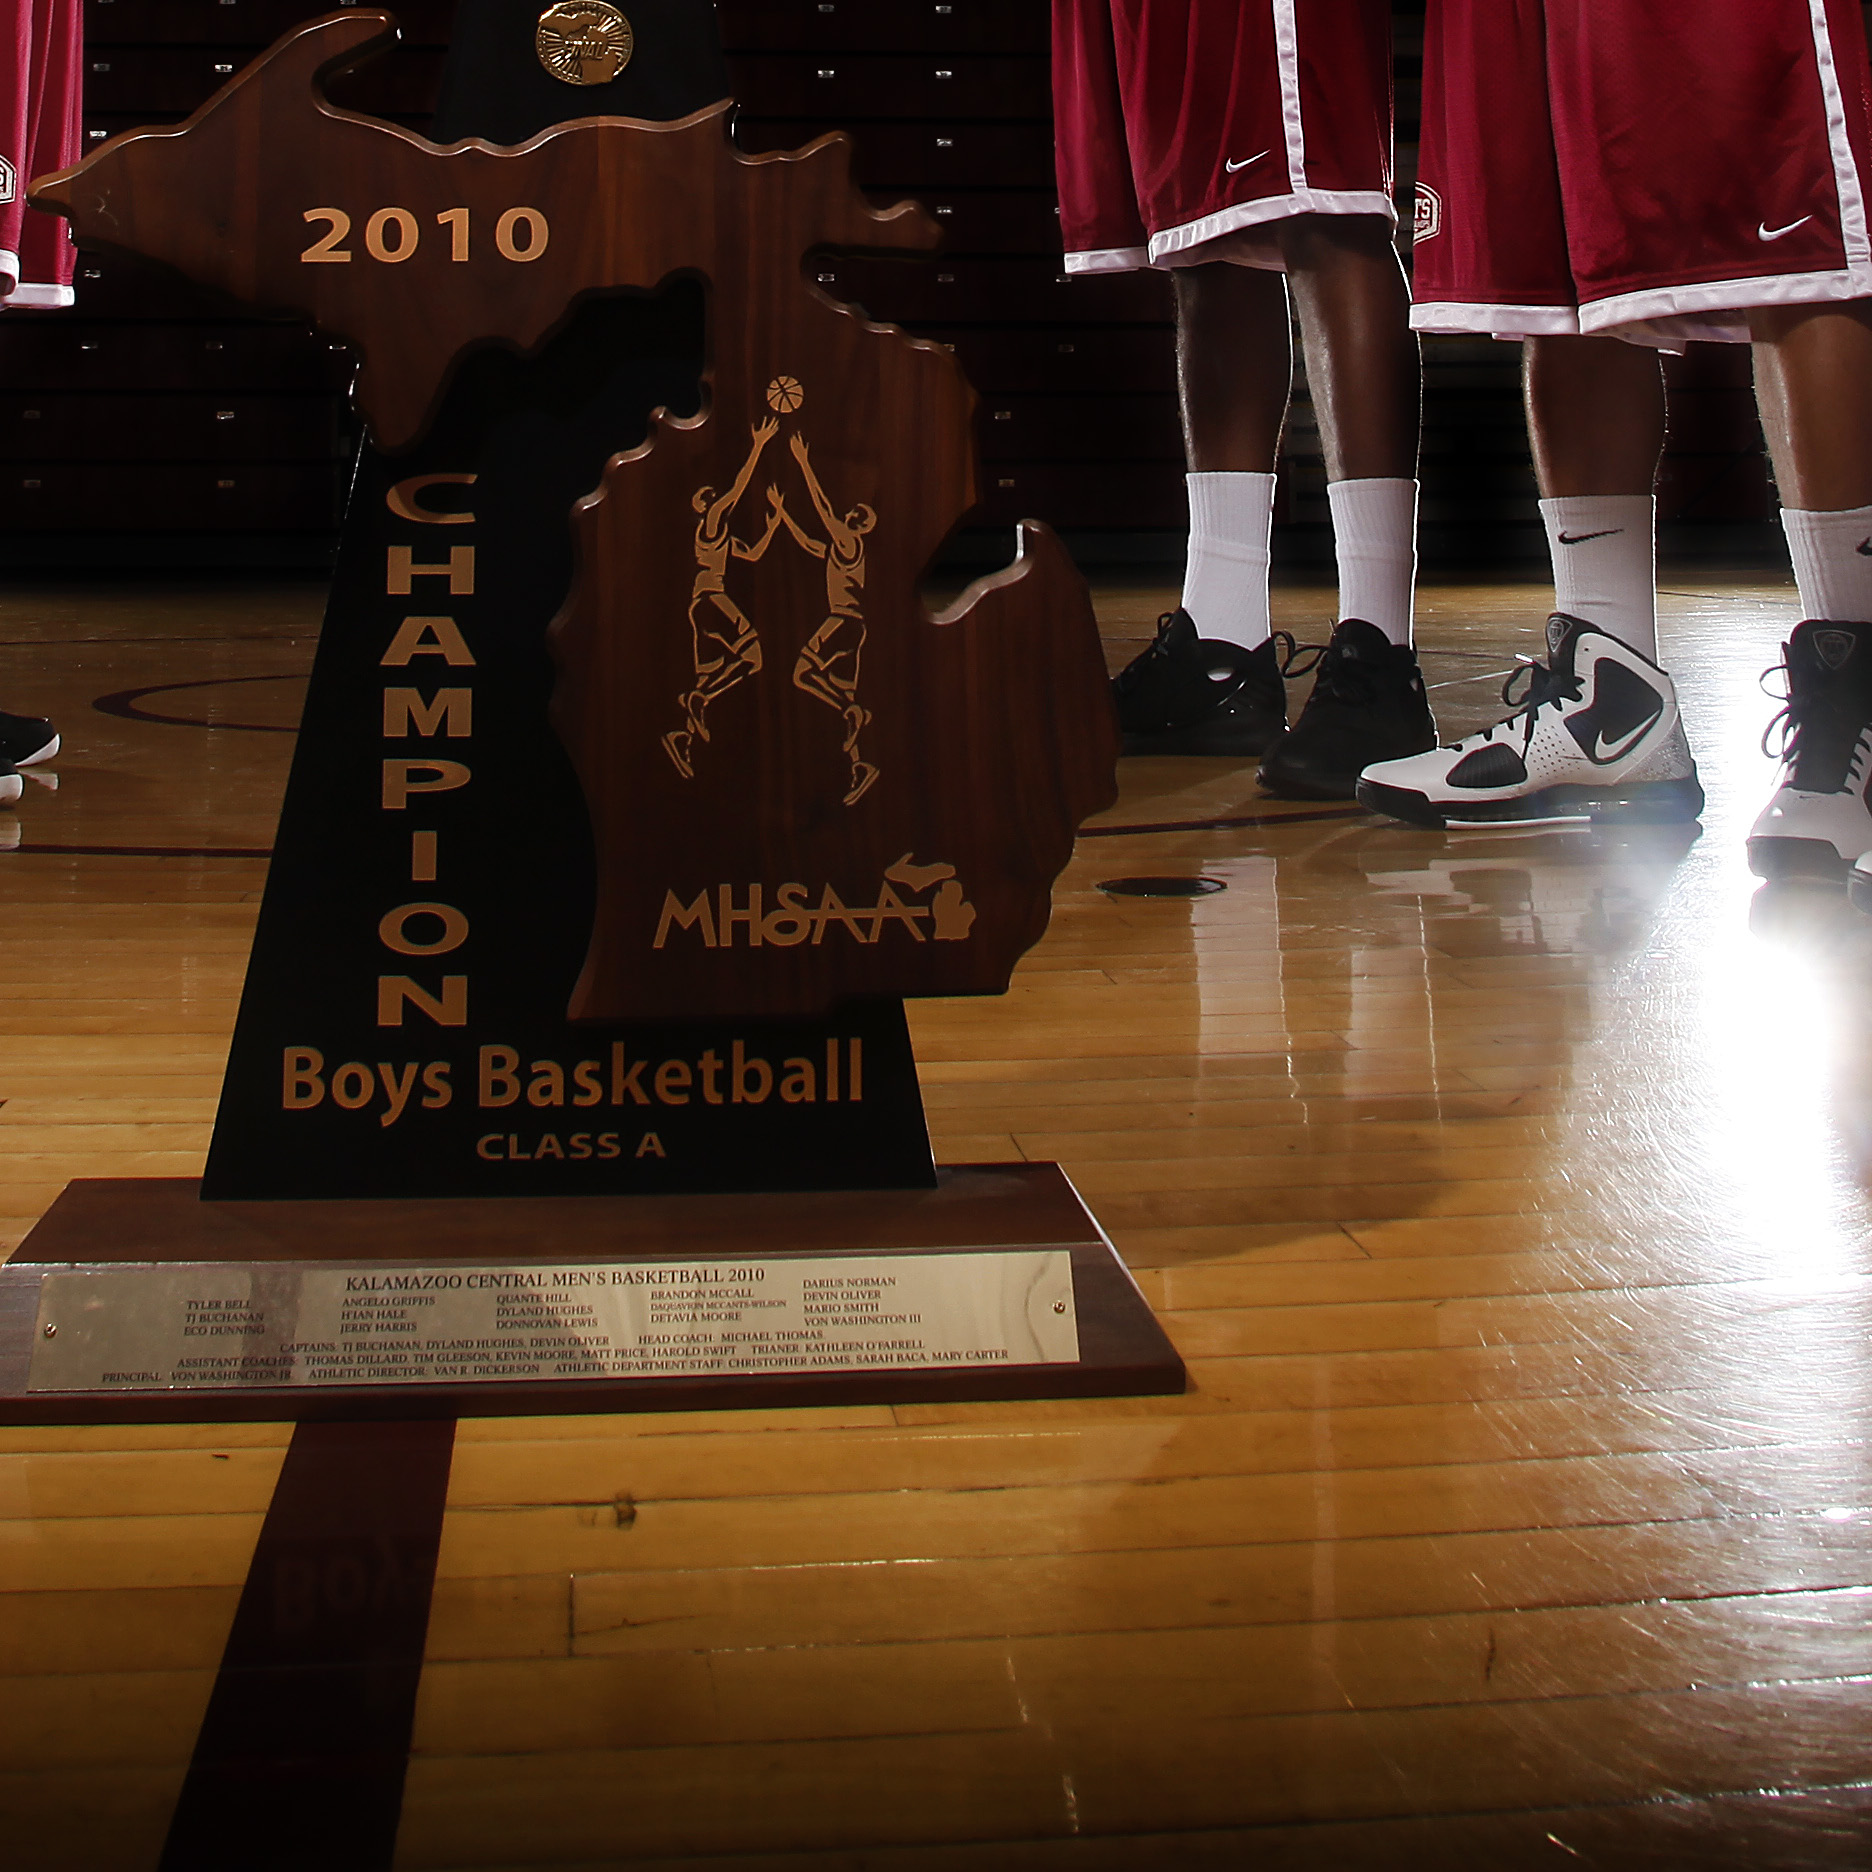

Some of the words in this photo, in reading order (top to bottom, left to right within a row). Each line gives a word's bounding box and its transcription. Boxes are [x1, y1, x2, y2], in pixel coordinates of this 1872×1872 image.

[301, 207, 549, 263] 2010
[376, 473, 478, 1026] CHAMPION
[653, 880, 928, 948] MHSAA
[282, 1045, 453, 1127] Boys
[478, 1037, 863, 1109] Basketball
[477, 1132, 622, 1160] CLASS
[635, 1132, 667, 1159] A
[346, 1275, 462, 1291] KALAMAZOO
[467, 1273, 548, 1289] CENTRAL
[552, 1271, 606, 1287] MEN'S
[611, 1268, 725, 1285] BASKETBALL
[728, 1268, 765, 1282] 2010
[803, 1278, 844, 1289] DARIUS
[846, 1277, 897, 1288] NORMAN
[496, 1293, 543, 1305] QUANTE
[545, 1293, 572, 1303] HILL
[650, 1289, 706, 1300] BRANDON
[708, 1288, 755, 1299] MCCALL
[803, 1291, 838, 1302] DEVIN
[840, 1289, 882, 1300] OLIVER
[187, 1299, 222, 1310] TYLER
[225, 1299, 252, 1310] BELL
[342, 1296, 390, 1307] ANGELO
[392, 1296, 436, 1306] GRIFFIS
[496, 1306, 544, 1317] DYLAND
[546, 1305, 594, 1316] HUGHES
[803, 1303, 841, 1314] MARIO
[843, 1302, 880, 1313] SMITH
[185, 1312, 197, 1324] TJ
[199, 1312, 265, 1323] BUCHANAN
[377, 1309, 408, 1320] HALE
[650, 1312, 698, 1323] DETAVIA
[700, 1311, 742, 1322] MOORE
[804, 1316, 829, 1327] VON
[831, 1314, 907, 1326] WASHINGTON
[909, 1314, 922, 1324] III
[340, 1322, 373, 1334] JERRY
[375, 1322, 418, 1332] HARRIS
[496, 1318, 562, 1329] DONNOVAN
[564, 1318, 599, 1328] LEWIS
[184, 1325, 207, 1336] ECO
[210, 1325, 266, 1336] DUNNING
[638, 1334, 671, 1345] HEAD
[720, 1331, 773, 1342] MICHAEL
[775, 1330, 824, 1341] THOMAS
[342, 1342, 353, 1354] TJ
[426, 1339, 474, 1351] DYLAND
[530, 1337, 565, 1348] DEVIN
[568, 1336, 610, 1347] OLIVER
[805, 1341, 864, 1353] KATHLEEN
[866, 1339, 925, 1351] O'FARRELL
[176, 1357, 240, 1368] ASSISTANT
[305, 1355, 354, 1366] THOMAS
[413, 1353, 434, 1364] TIM
[495, 1350, 531, 1361] KEVIN
[581, 1349, 612, 1359] MATT
[652, 1346, 701, 1357] HAROLD
[703, 1345, 737, 1356] SWIFT
[554, 1362, 609, 1374] ATHLETIC
[612, 1359, 688, 1372] DEPARTMENT
[728, 1355, 808, 1369] CHRISTOPHER
[856, 1352, 894, 1364] SARAH
[932, 1350, 964, 1362] MARY
[965, 1349, 1009, 1360] CARTER
[171, 1370, 197, 1381] VON
[198, 1369, 277, 1381] WASHINGTON
[309, 1367, 367, 1379] ATHLETIC
[434, 1366, 458, 1377] VAN
[473, 1363, 540, 1375] DICKERSON
